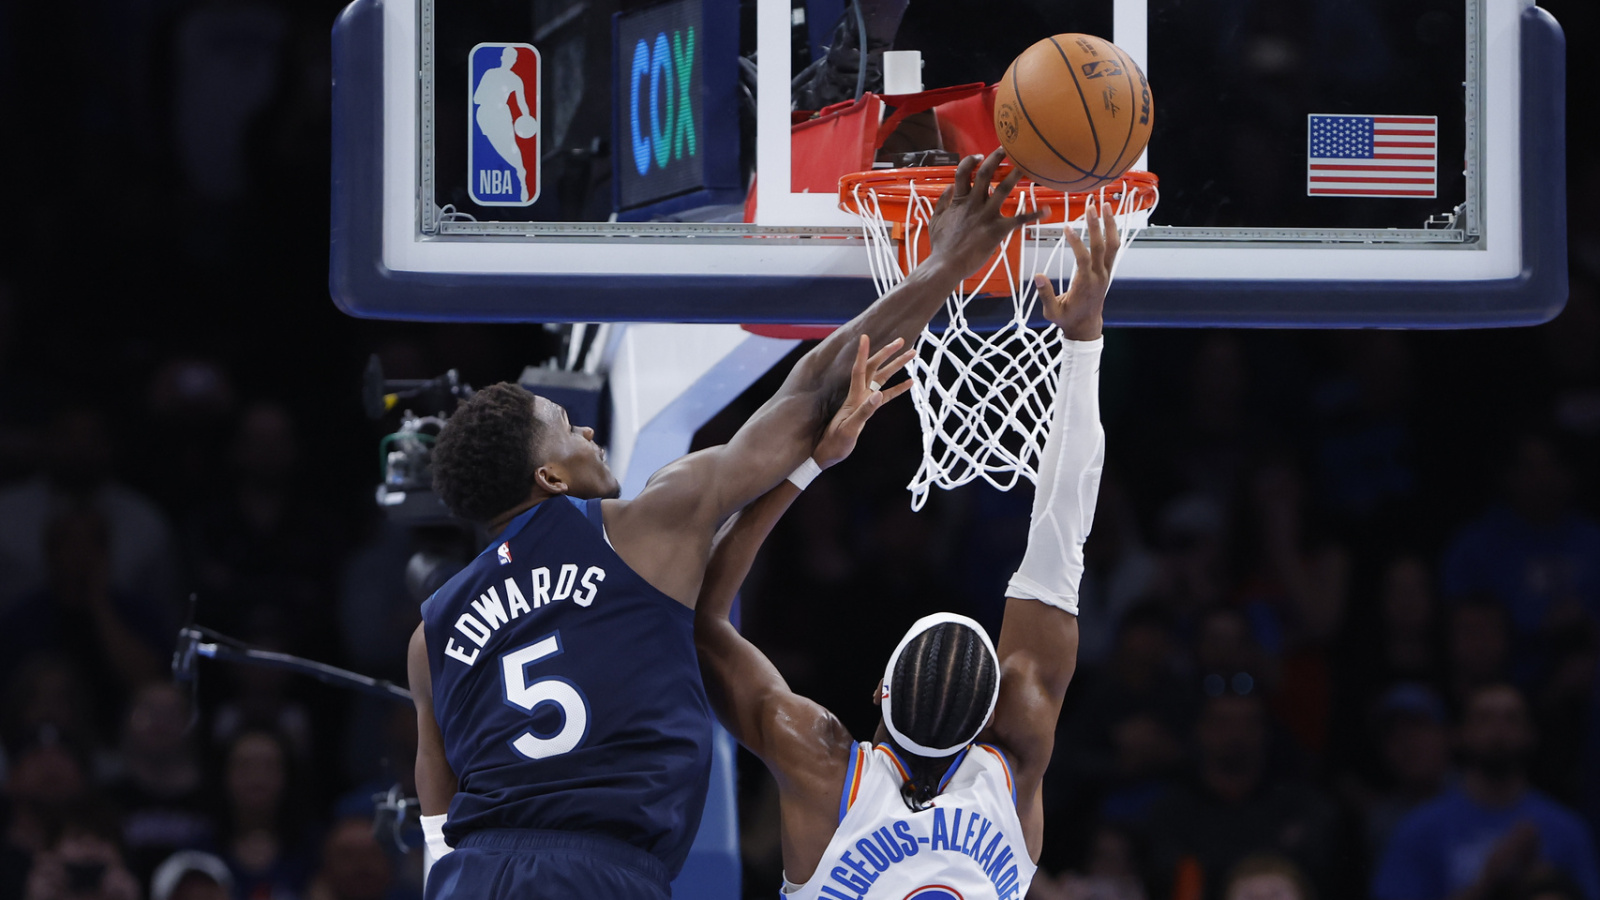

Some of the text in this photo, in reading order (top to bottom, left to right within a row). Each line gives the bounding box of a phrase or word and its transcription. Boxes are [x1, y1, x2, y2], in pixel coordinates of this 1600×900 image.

[630, 26, 696, 177] COX
[479, 169, 513, 195] NBA
[444, 563, 606, 667] EDWARDS
[502, 634, 588, 760] 5
[817, 807, 1020, 900] LGEOUS-ALEXANDE
